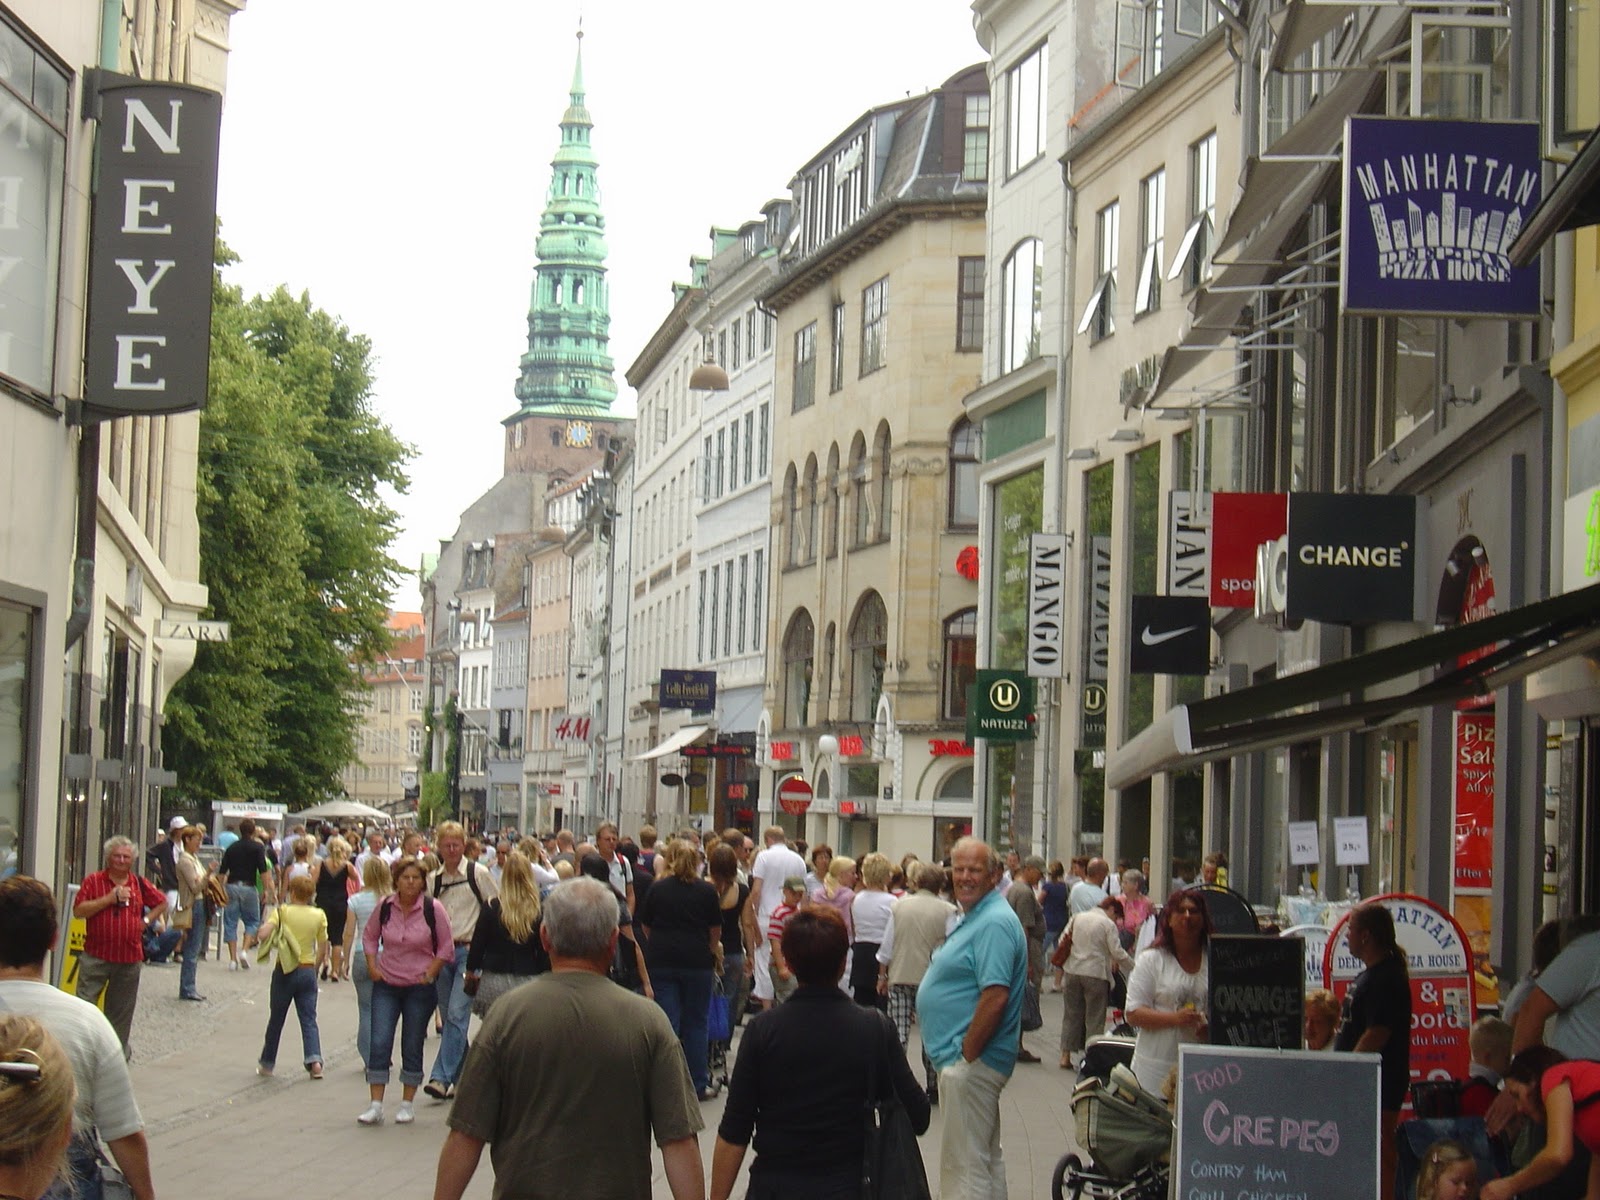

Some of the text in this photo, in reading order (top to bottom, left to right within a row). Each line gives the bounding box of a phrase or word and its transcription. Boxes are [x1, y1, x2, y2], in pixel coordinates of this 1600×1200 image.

[1356, 153, 1538, 206] MANHATTAN
[113, 98, 183, 392] NEYE
[1379, 259, 1512, 283] PIZZA HOUSE
[1174, 506, 1206, 592] MAN
[1299, 544, 1402, 568] CHANGE
[1032, 546, 1061, 665] MANGO
[170, 624, 226, 641] ZARA
[981, 718, 1028, 731] NATUZZI
[1464, 723, 1495, 742] Piz
[1428, 955, 1461, 968] HOUSE
[1214, 985, 1300, 1016] ORANGE
[1202, 1099, 1341, 1157] CREPES
[1190, 1159, 1245, 1180] CONTRY
